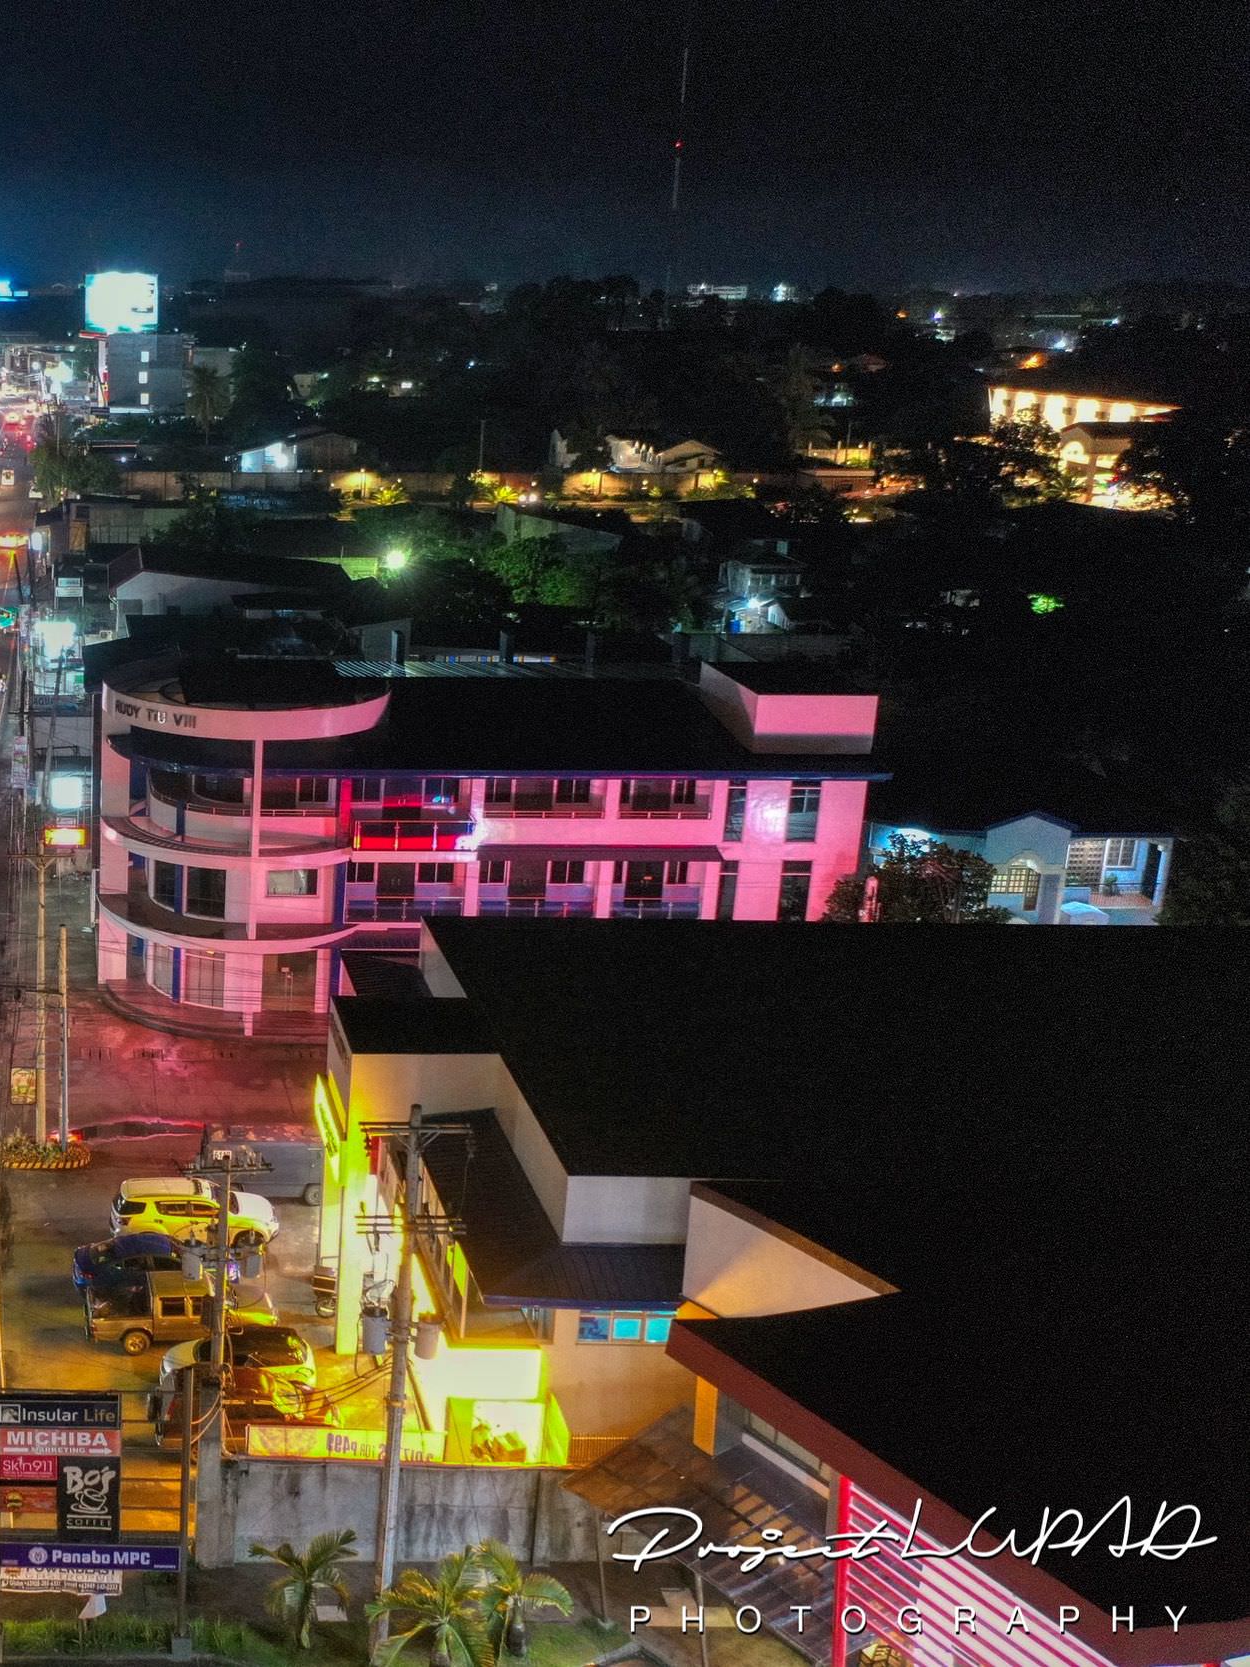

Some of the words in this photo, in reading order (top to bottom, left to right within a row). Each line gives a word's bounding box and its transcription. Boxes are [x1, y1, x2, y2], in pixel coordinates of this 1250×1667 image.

[115, 699, 141, 719] RUDY
[173, 713, 197, 729] VIII
[22, 1408, 78, 1422] Insular
[84, 1409, 116, 1422] Life
[7, 1431, 108, 1447] MICHIBA
[63, 1466, 116, 1495] Bo's
[52, 1550, 111, 1564] Panabo
[113, 1551, 151, 1565] MPC
